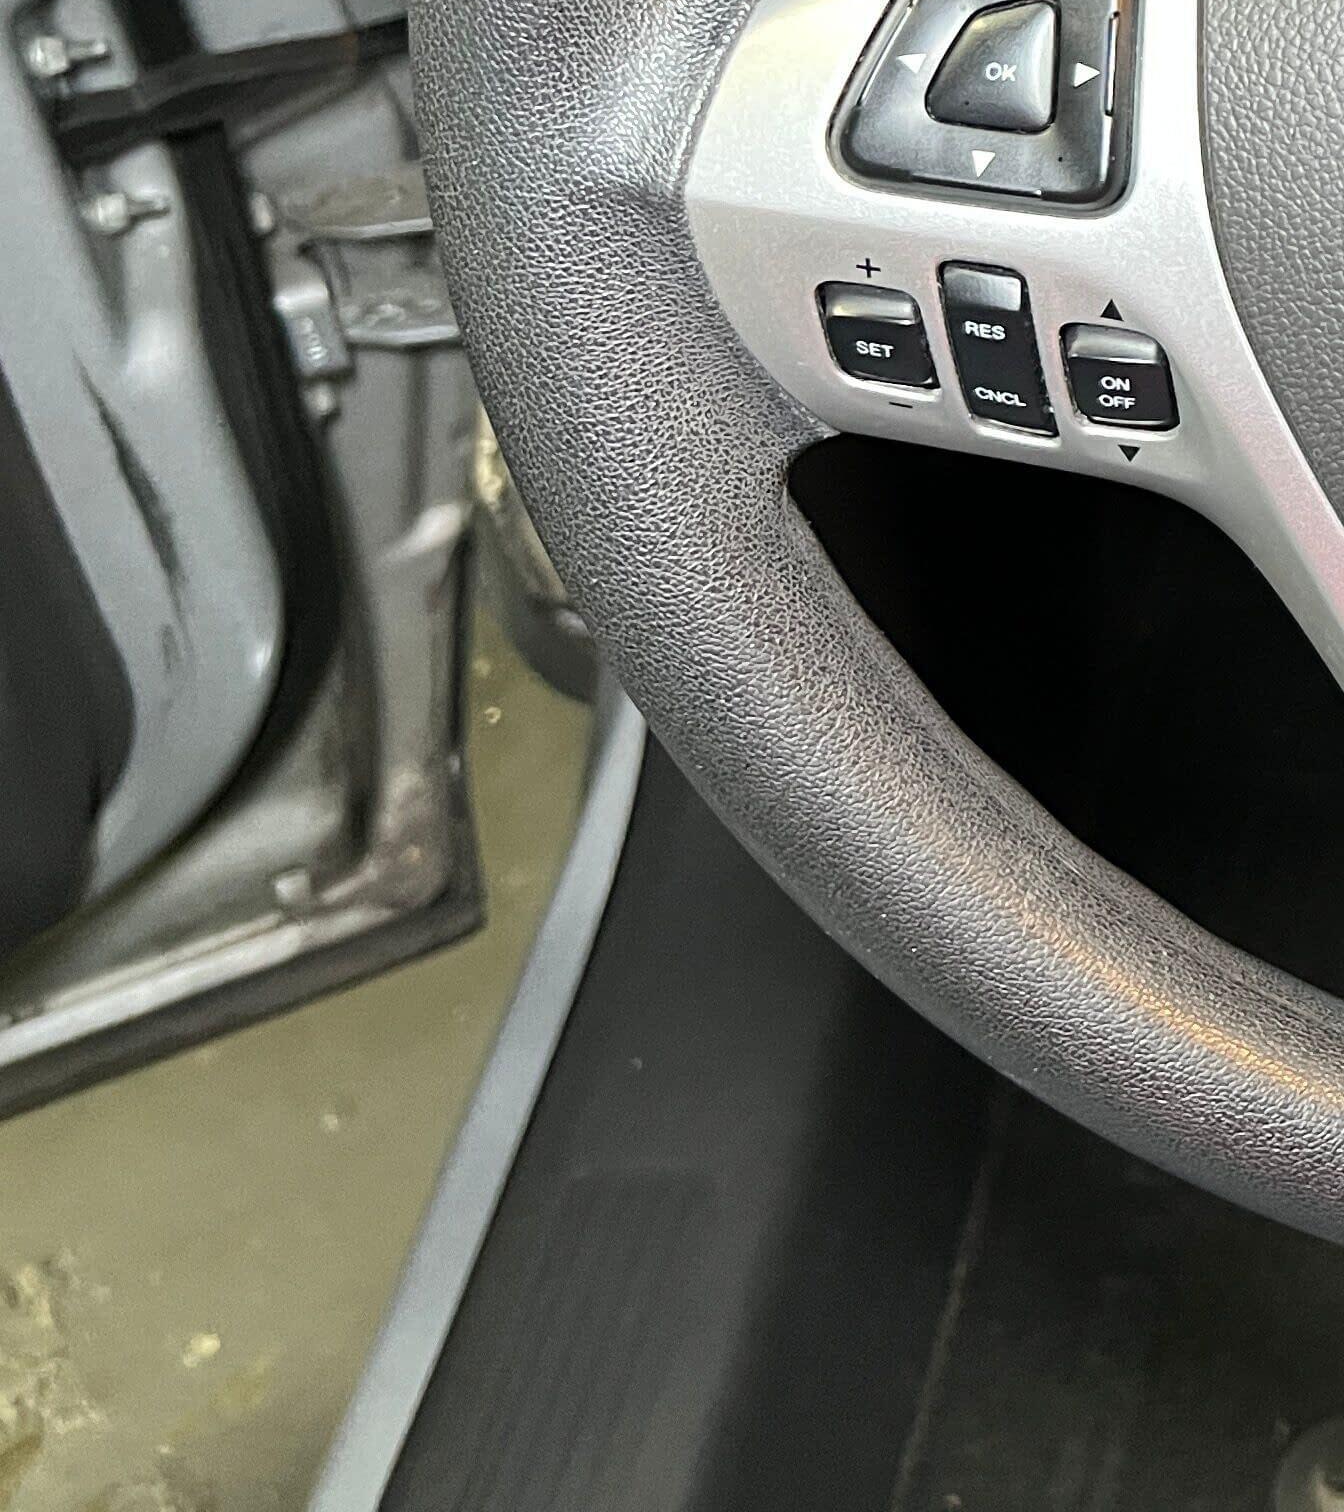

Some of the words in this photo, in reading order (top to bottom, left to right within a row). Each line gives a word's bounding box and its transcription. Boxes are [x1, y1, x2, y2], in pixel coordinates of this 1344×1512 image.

[984, 61, 1017, 83] OK
[964, 320, 1006, 341] RES
[856, 340, 895, 359] SET
[1100, 375, 1131, 392] ON
[974, 386, 1027, 408] CNCL
[1098, 393, 1136, 410] OFF
